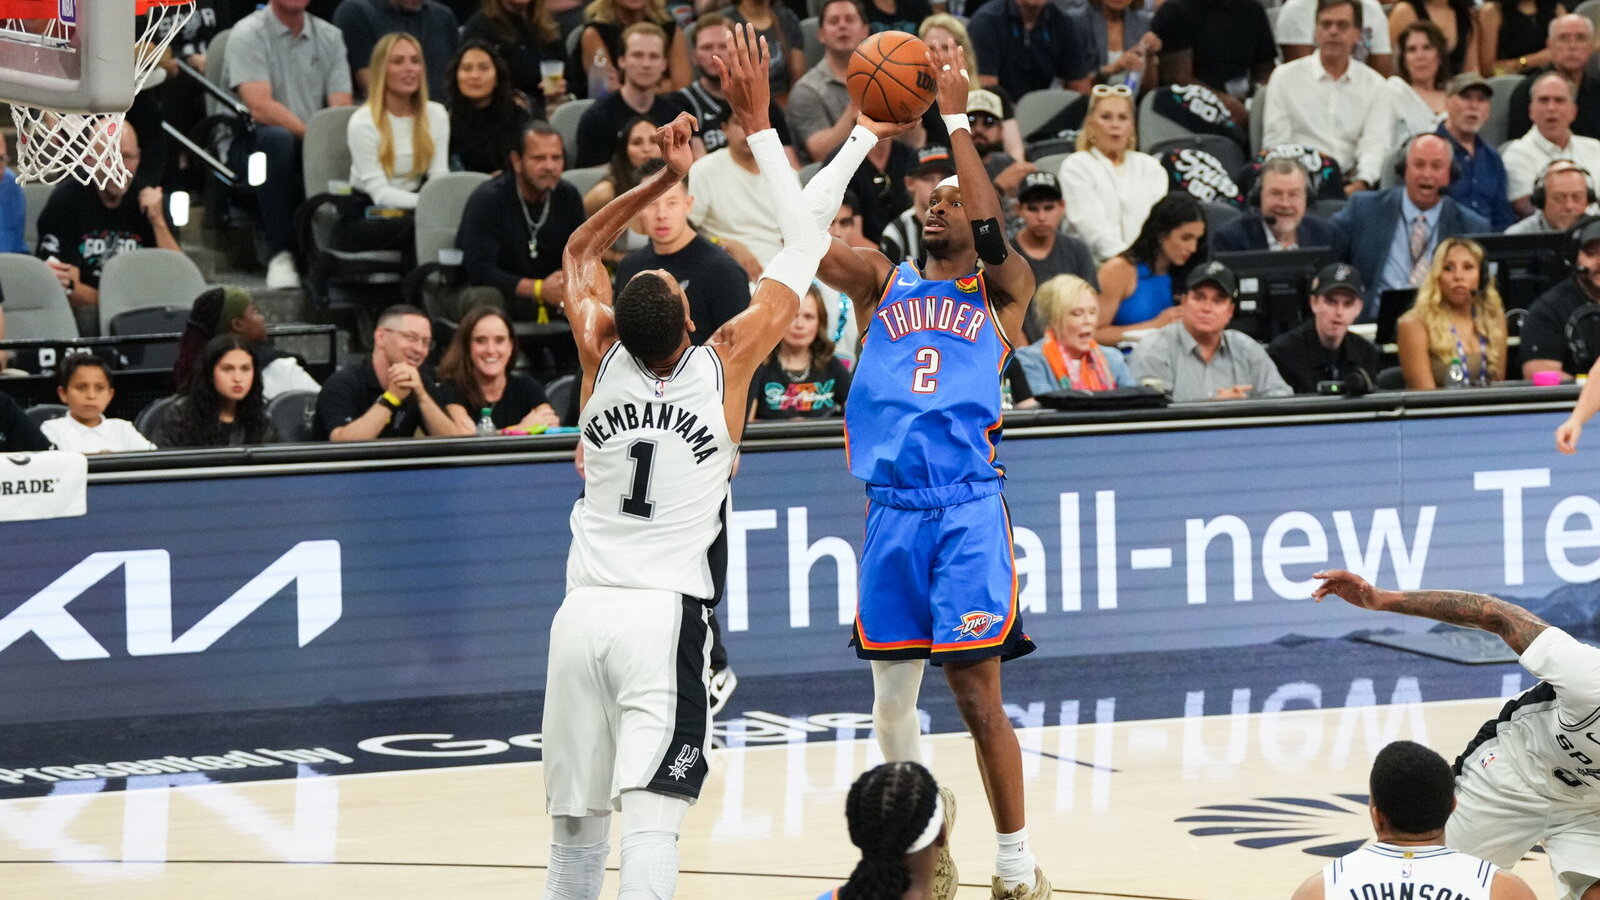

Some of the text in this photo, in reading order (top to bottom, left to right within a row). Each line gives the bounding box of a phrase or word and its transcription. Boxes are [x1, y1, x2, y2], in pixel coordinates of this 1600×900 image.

[877, 296, 987, 343] THUNDER
[911, 346, 942, 394] 2
[584, 402, 719, 465] WEMBANYAMA
[0, 479, 55, 495] RADE
[618, 437, 659, 521] 1
[727, 468, 1600, 632] Th all-new Te
[963, 616, 988, 634] OKC
[254, 747, 355, 765] by
[357, 710, 873, 758] Ggle
[1350, 882, 1472, 900] OHNSO
